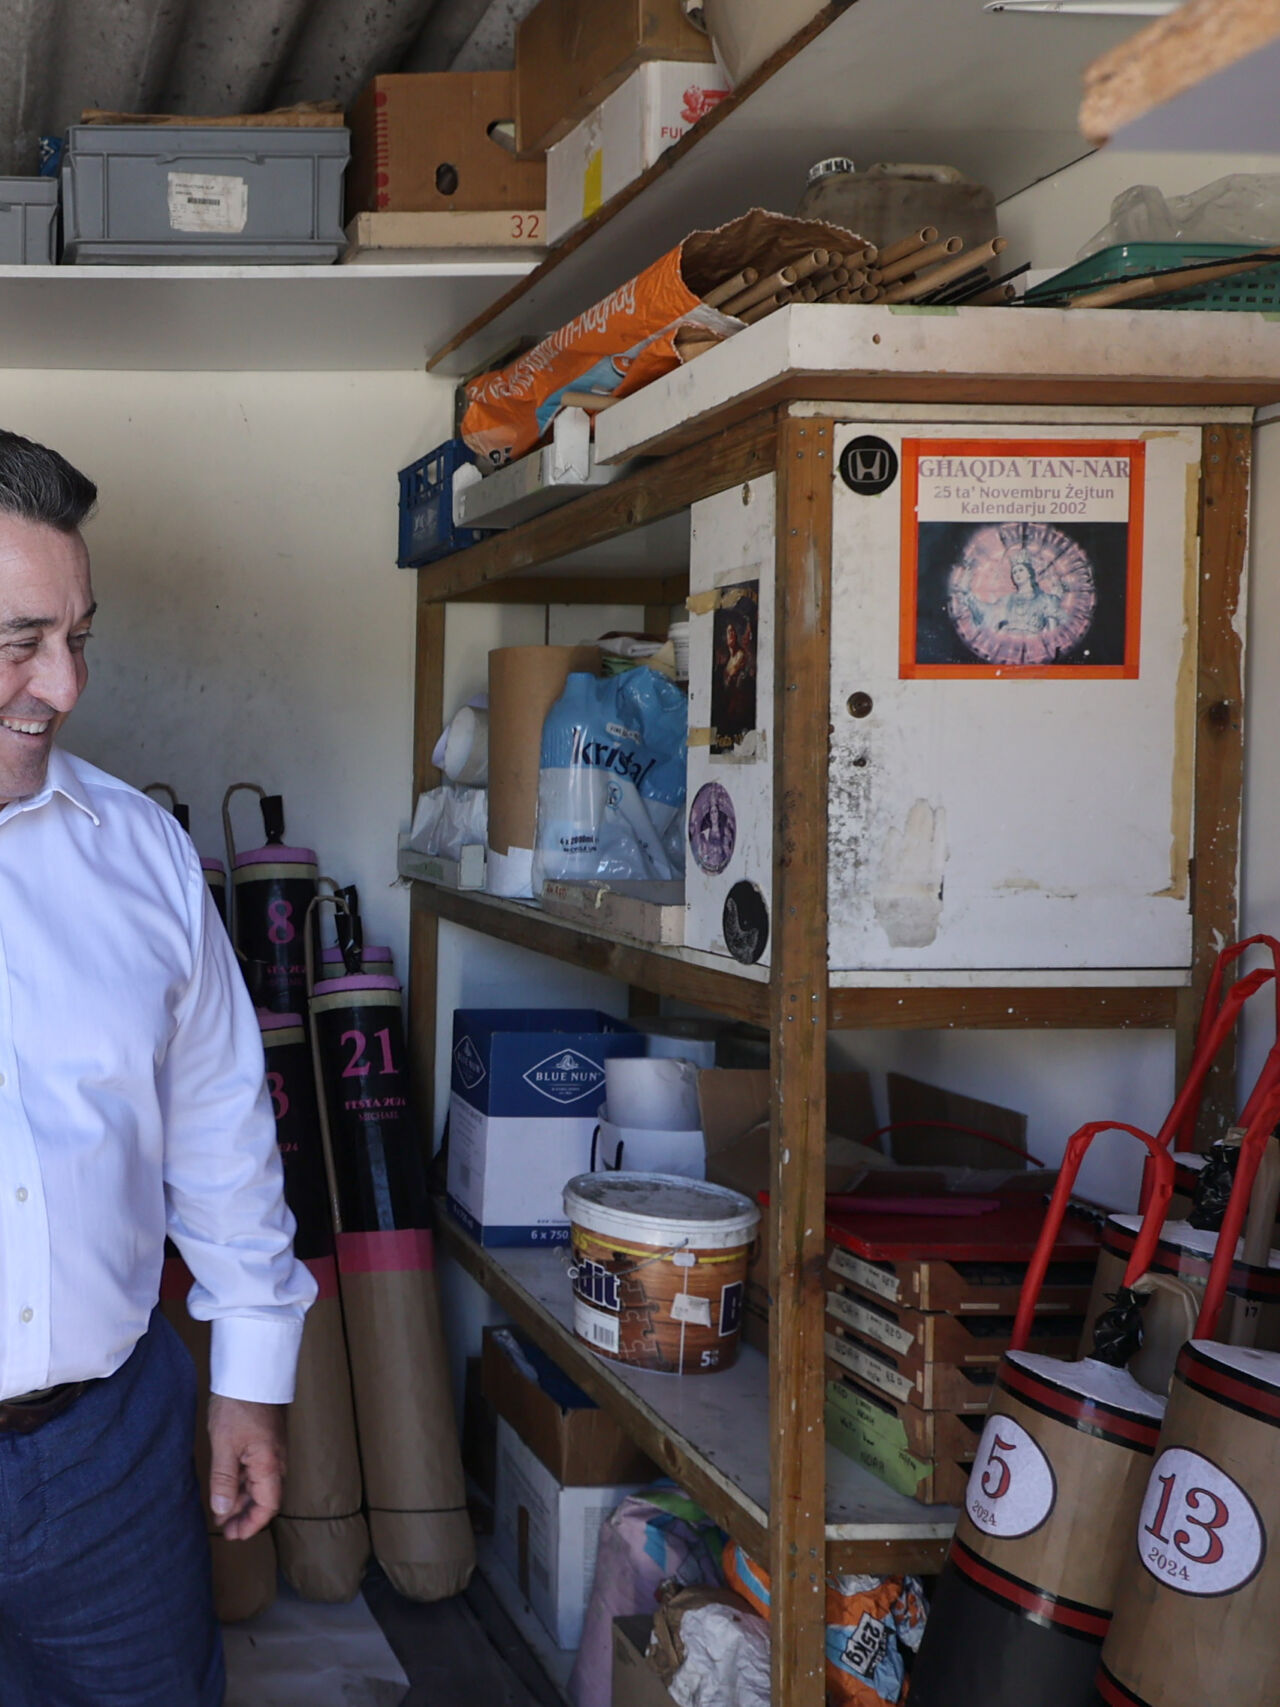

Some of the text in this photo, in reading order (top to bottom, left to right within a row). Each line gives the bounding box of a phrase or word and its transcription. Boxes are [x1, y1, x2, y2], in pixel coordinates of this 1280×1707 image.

[511, 214, 540, 239] 32
[1027, 459, 1130, 479] TAN-NAR
[933, 485, 952, 499] 25
[980, 486, 1061, 500] Novembru
[1065, 483, 1115, 502] Żejtun
[961, 501, 1087, 517] Kalendarju 2002
[267, 900, 295, 944] 8
[339, 1027, 399, 1079] 21
[535, 1072, 598, 1082] BLUE NUN
[530, 1230, 538, 1240] 6
[540, 1232, 547, 1240] x
[1244, 1306, 1259, 1319] 17
[981, 1433, 1017, 1500] 5
[970, 1499, 998, 1528] 2024
[1144, 1472, 1230, 1565] 13
[1147, 1546, 1191, 1582] 2024
